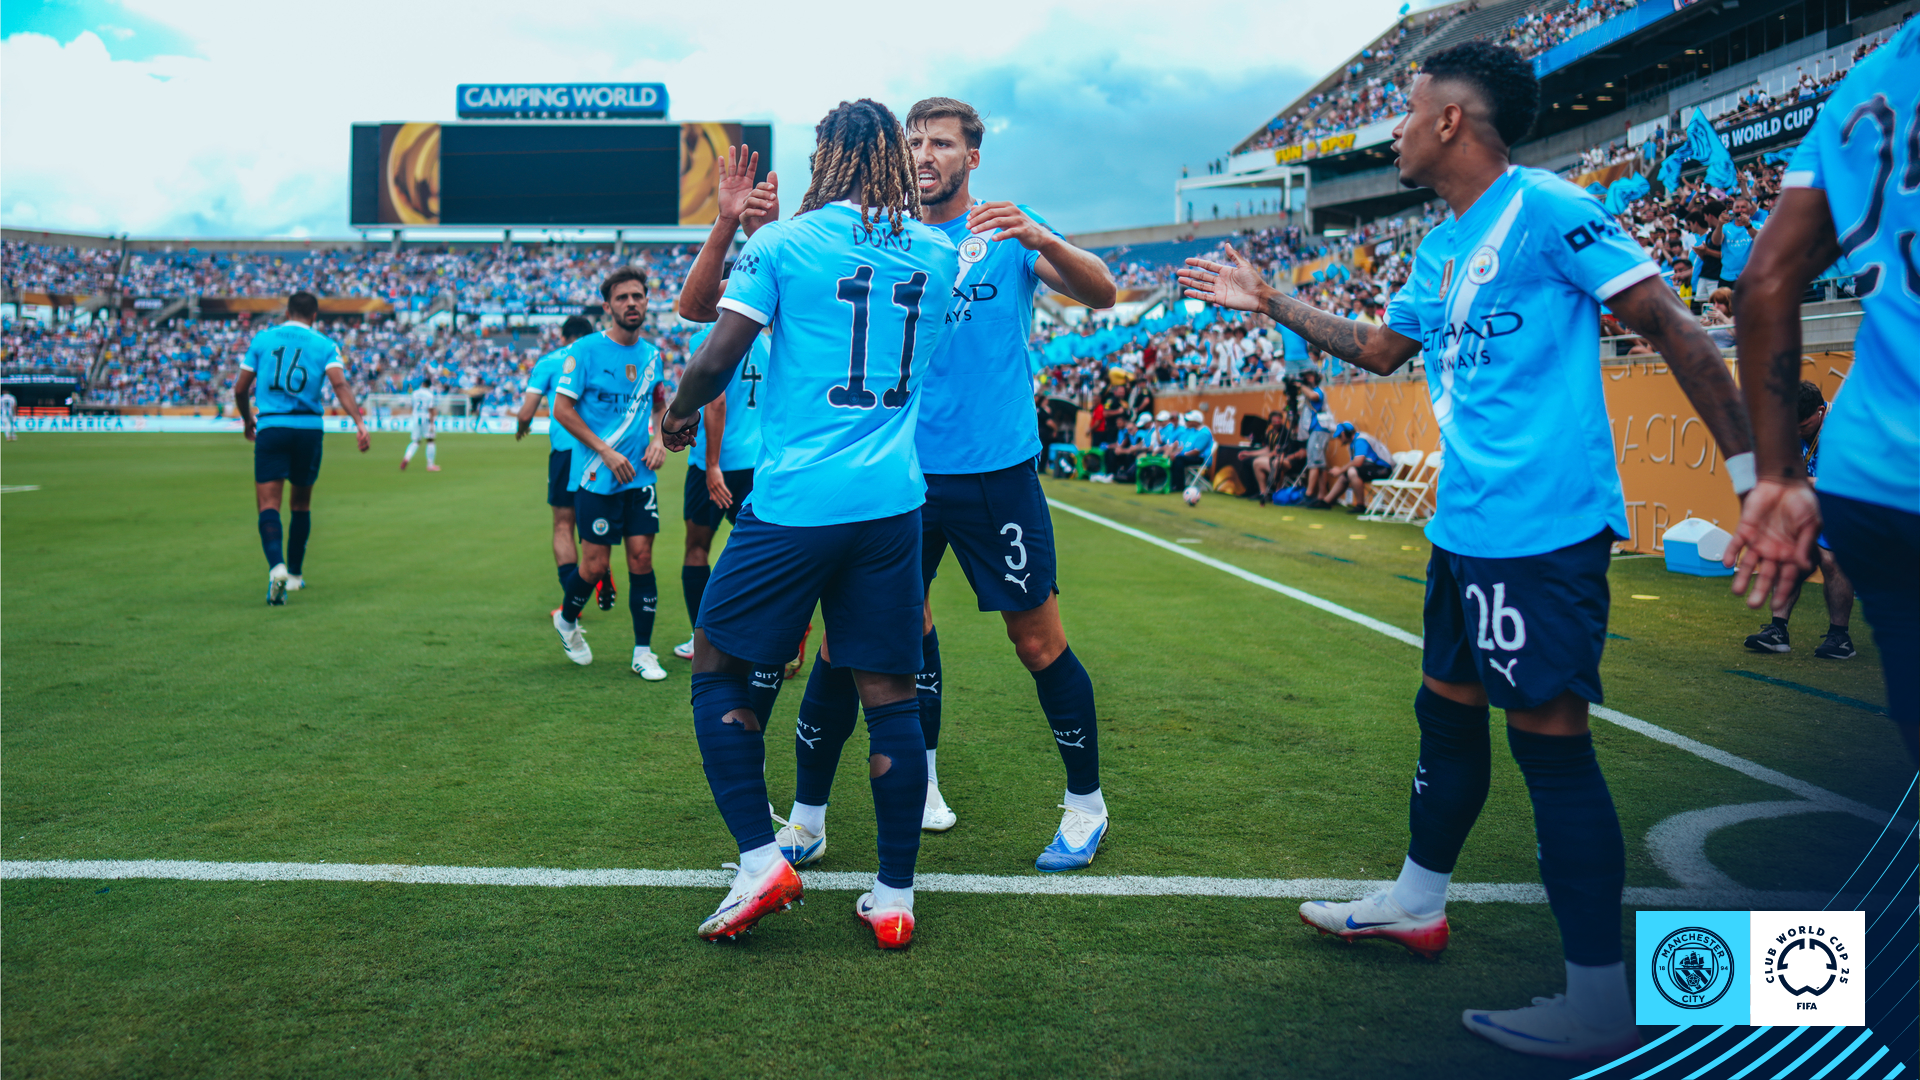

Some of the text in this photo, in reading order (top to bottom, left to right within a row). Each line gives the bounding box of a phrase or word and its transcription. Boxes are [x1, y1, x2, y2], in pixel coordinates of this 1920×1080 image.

[464, 87, 657, 107] CAMPING WORLD
[514, 110, 607, 119] STADIUM
[1731, 116, 1782, 147] WORLD
[1784, 105, 1814, 132] CUP
[1275, 133, 1356, 165] FUN SPOT
[852, 223, 912, 252] DOKU
[827, 265, 929, 411] 11
[1422, 311, 1524, 352] ETIHAD
[268, 346, 309, 395] 16
[1432, 349, 1491, 374] AIRWAYS
[50, 417, 123, 431] AMERICA
[1000, 523, 1027, 570] 3
[1465, 582, 1526, 651] 26
[915, 672, 937, 680] ITY
